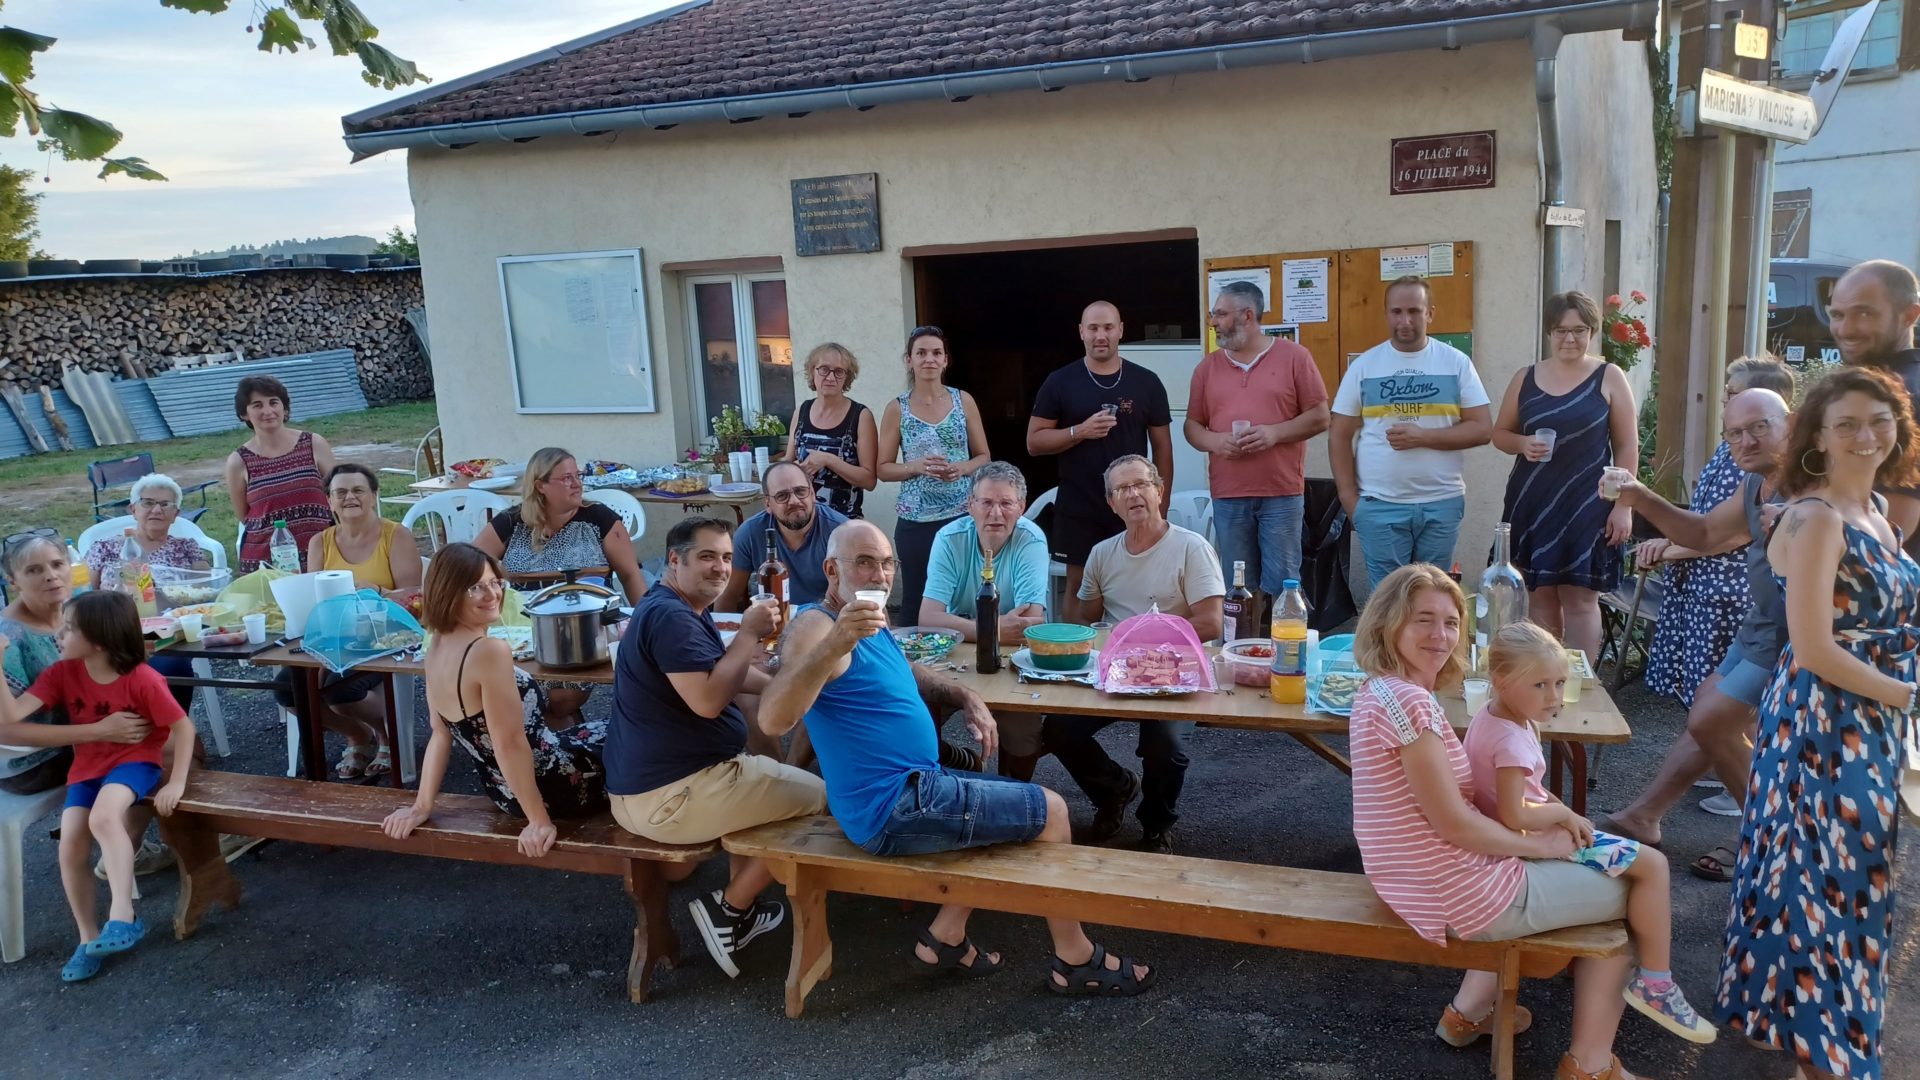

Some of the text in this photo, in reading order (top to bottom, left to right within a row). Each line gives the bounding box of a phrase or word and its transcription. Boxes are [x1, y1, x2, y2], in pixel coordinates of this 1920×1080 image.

[1704, 85, 1746, 116] MARIGNA
[1758, 98, 1794, 127] VALOUSE
[1802, 111, 1809, 130] 2
[1417, 146, 1469, 161] PLACE du
[1398, 163, 1488, 182] 16 JUILLET 1944
[1394, 402, 1423, 414] SURF
